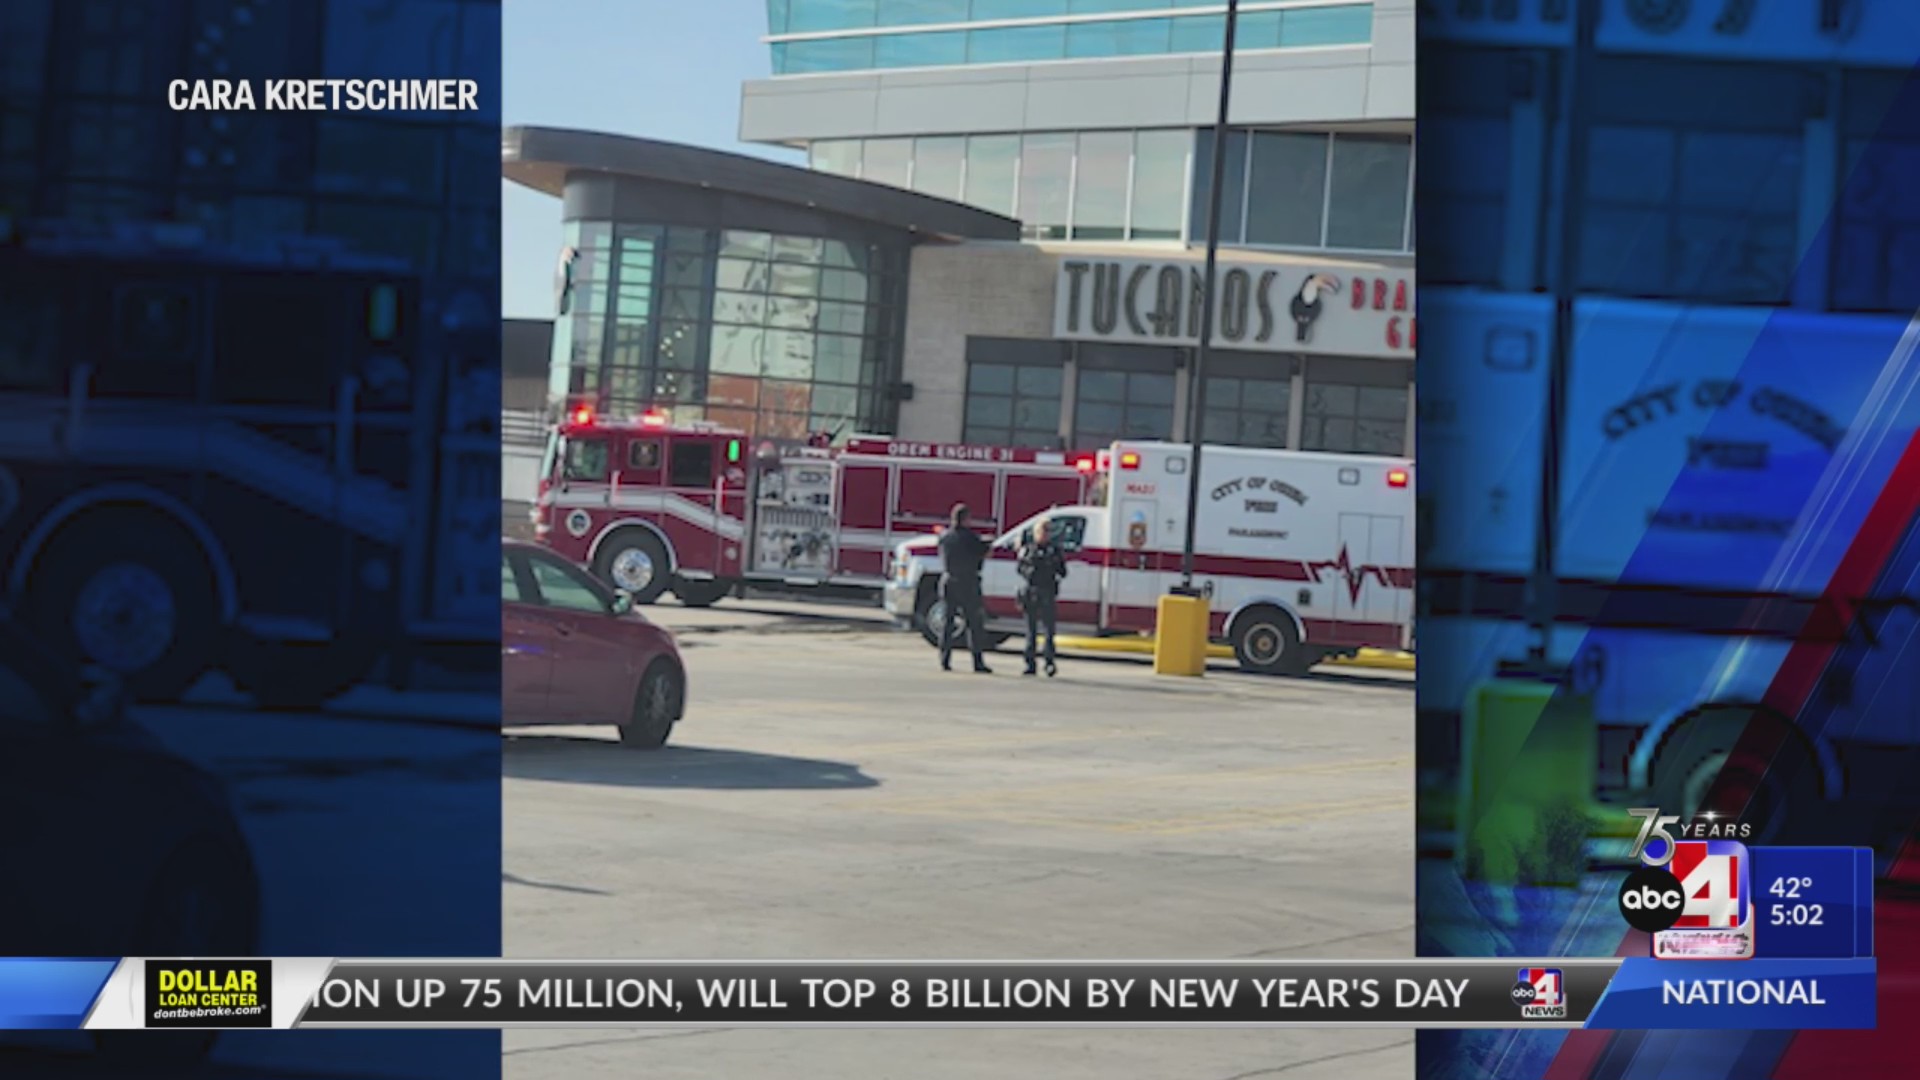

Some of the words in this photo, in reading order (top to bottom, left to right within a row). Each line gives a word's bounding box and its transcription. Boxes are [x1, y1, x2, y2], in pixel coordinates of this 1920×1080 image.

[1063, 261, 1278, 342] TUCANOS
[888, 442, 930, 457] OREM
[937, 445, 993, 460] ENGINE
